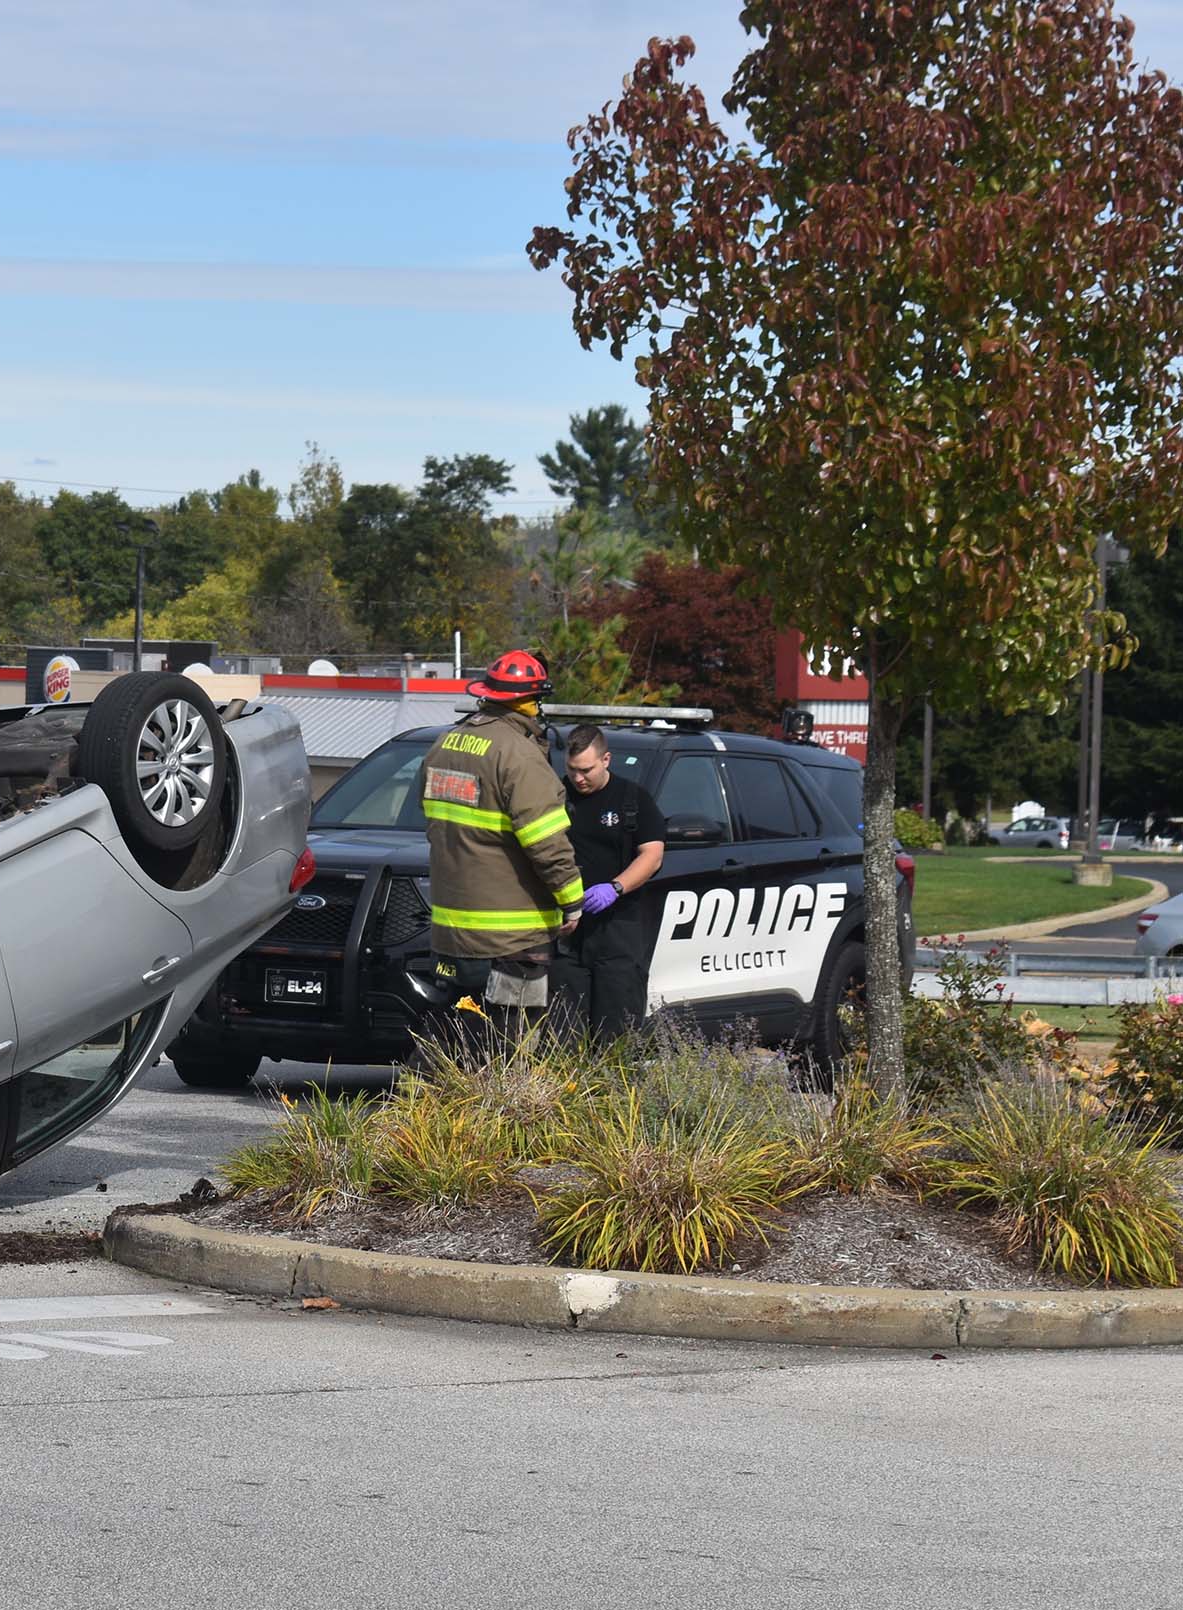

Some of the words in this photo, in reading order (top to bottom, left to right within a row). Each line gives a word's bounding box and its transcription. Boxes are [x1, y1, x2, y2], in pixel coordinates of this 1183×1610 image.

[47, 667, 70, 683] BURGER
[47, 677, 70, 696] KING
[809, 730, 835, 745] RIVE
[836, 731, 868, 745] THRU
[660, 882, 848, 941] POLICE
[700, 949, 787, 973] ELLICOTT
[287, 979, 322, 994] EL-24
